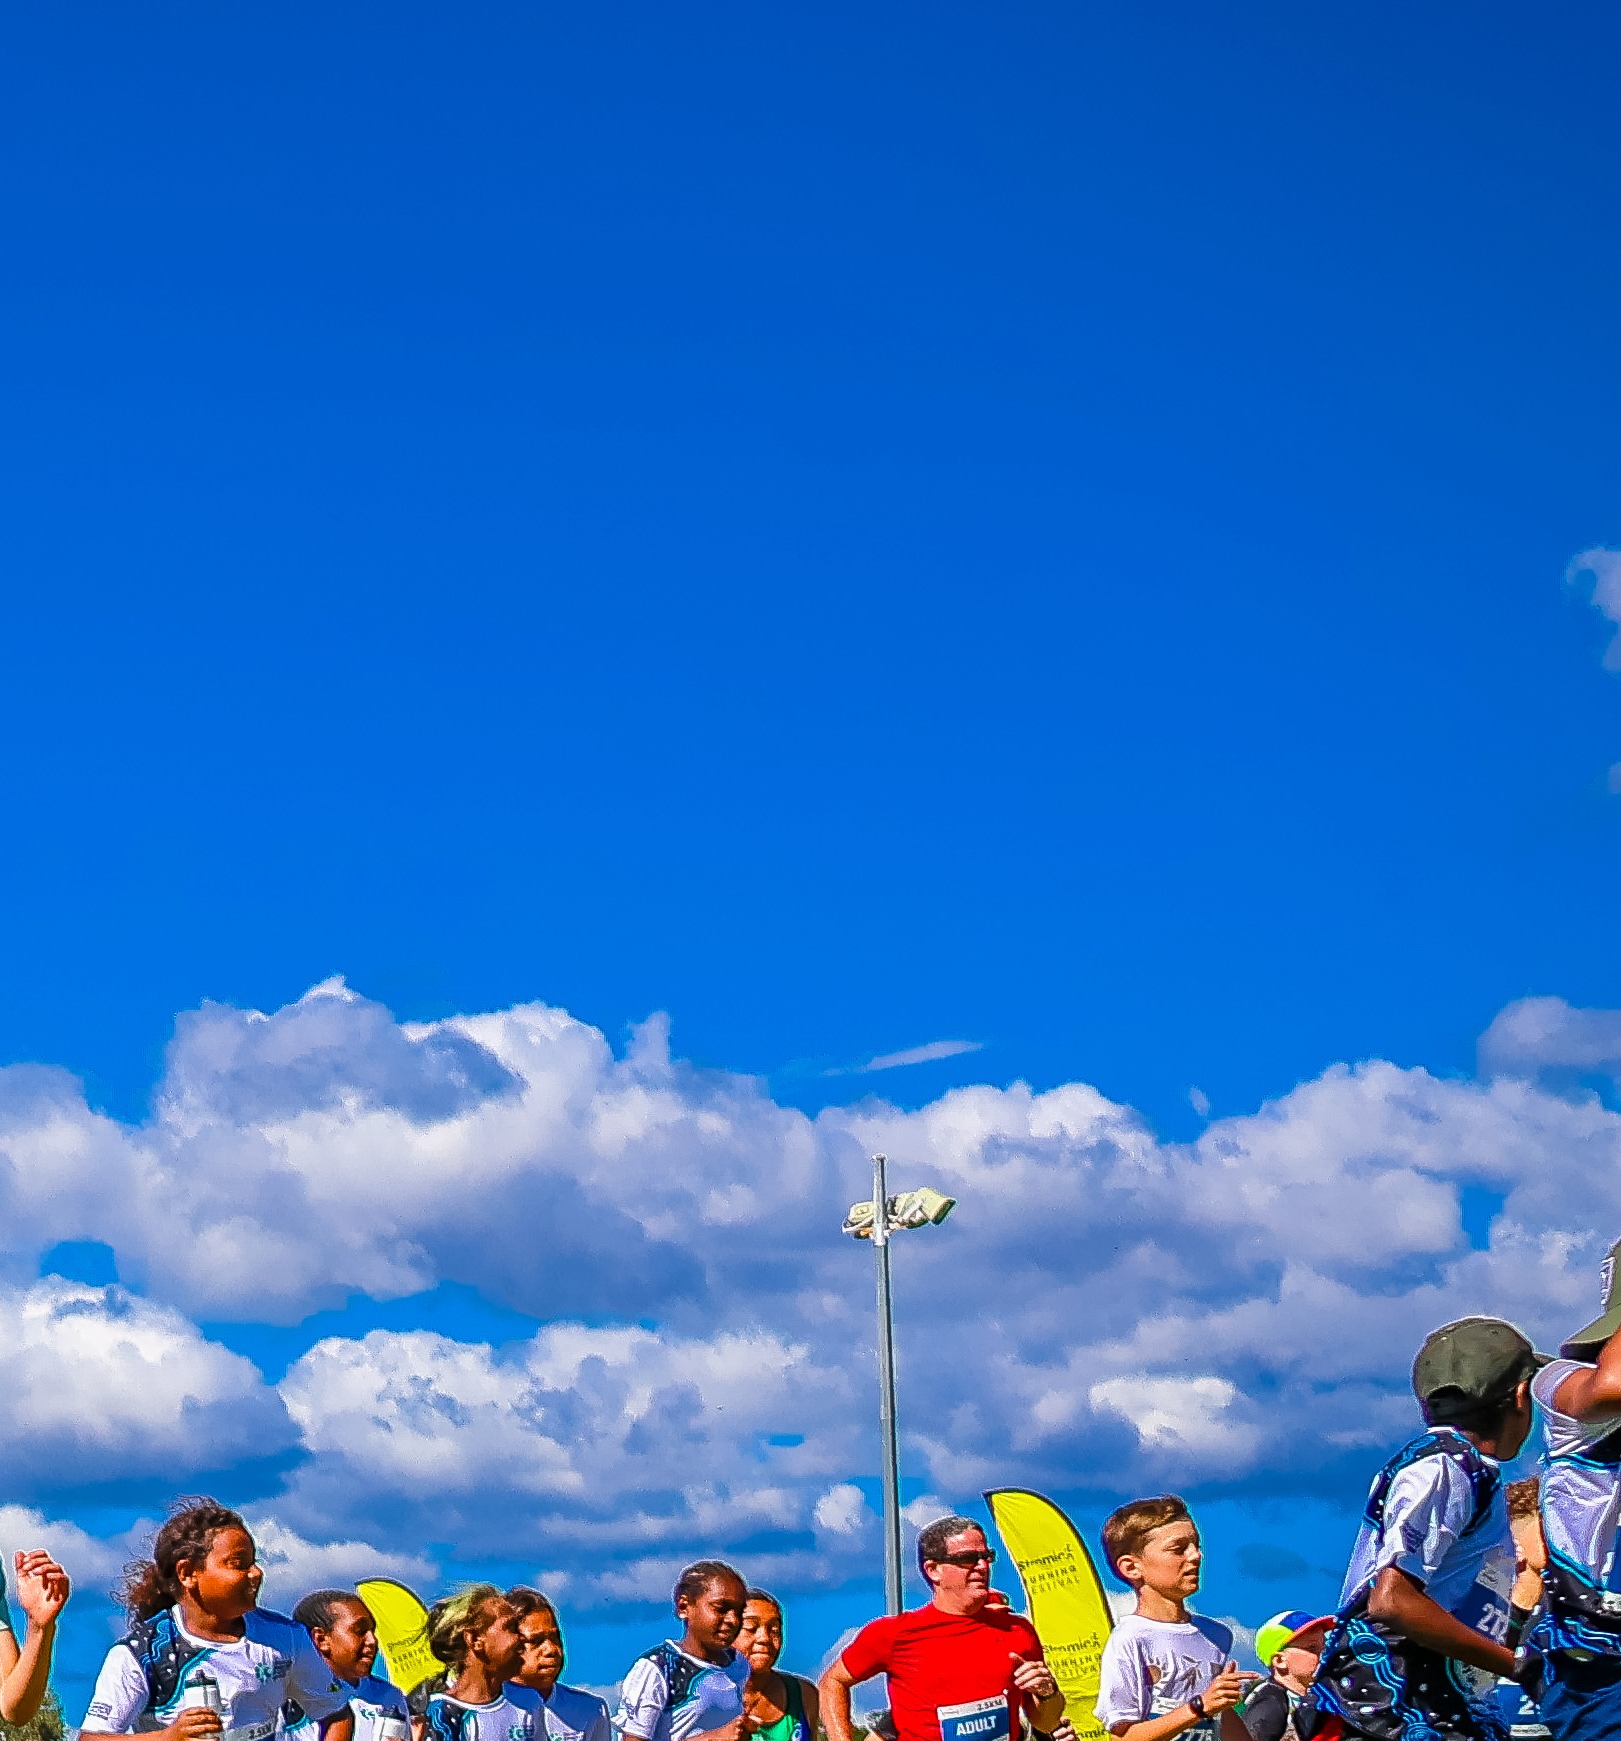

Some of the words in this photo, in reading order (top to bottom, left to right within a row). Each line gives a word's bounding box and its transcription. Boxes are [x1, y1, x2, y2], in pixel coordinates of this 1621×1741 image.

[1030, 1565, 1077, 1584] UNNING
[1032, 1578, 1080, 1595] ESTIVAL
[956, 1715, 997, 1736] ADULT
